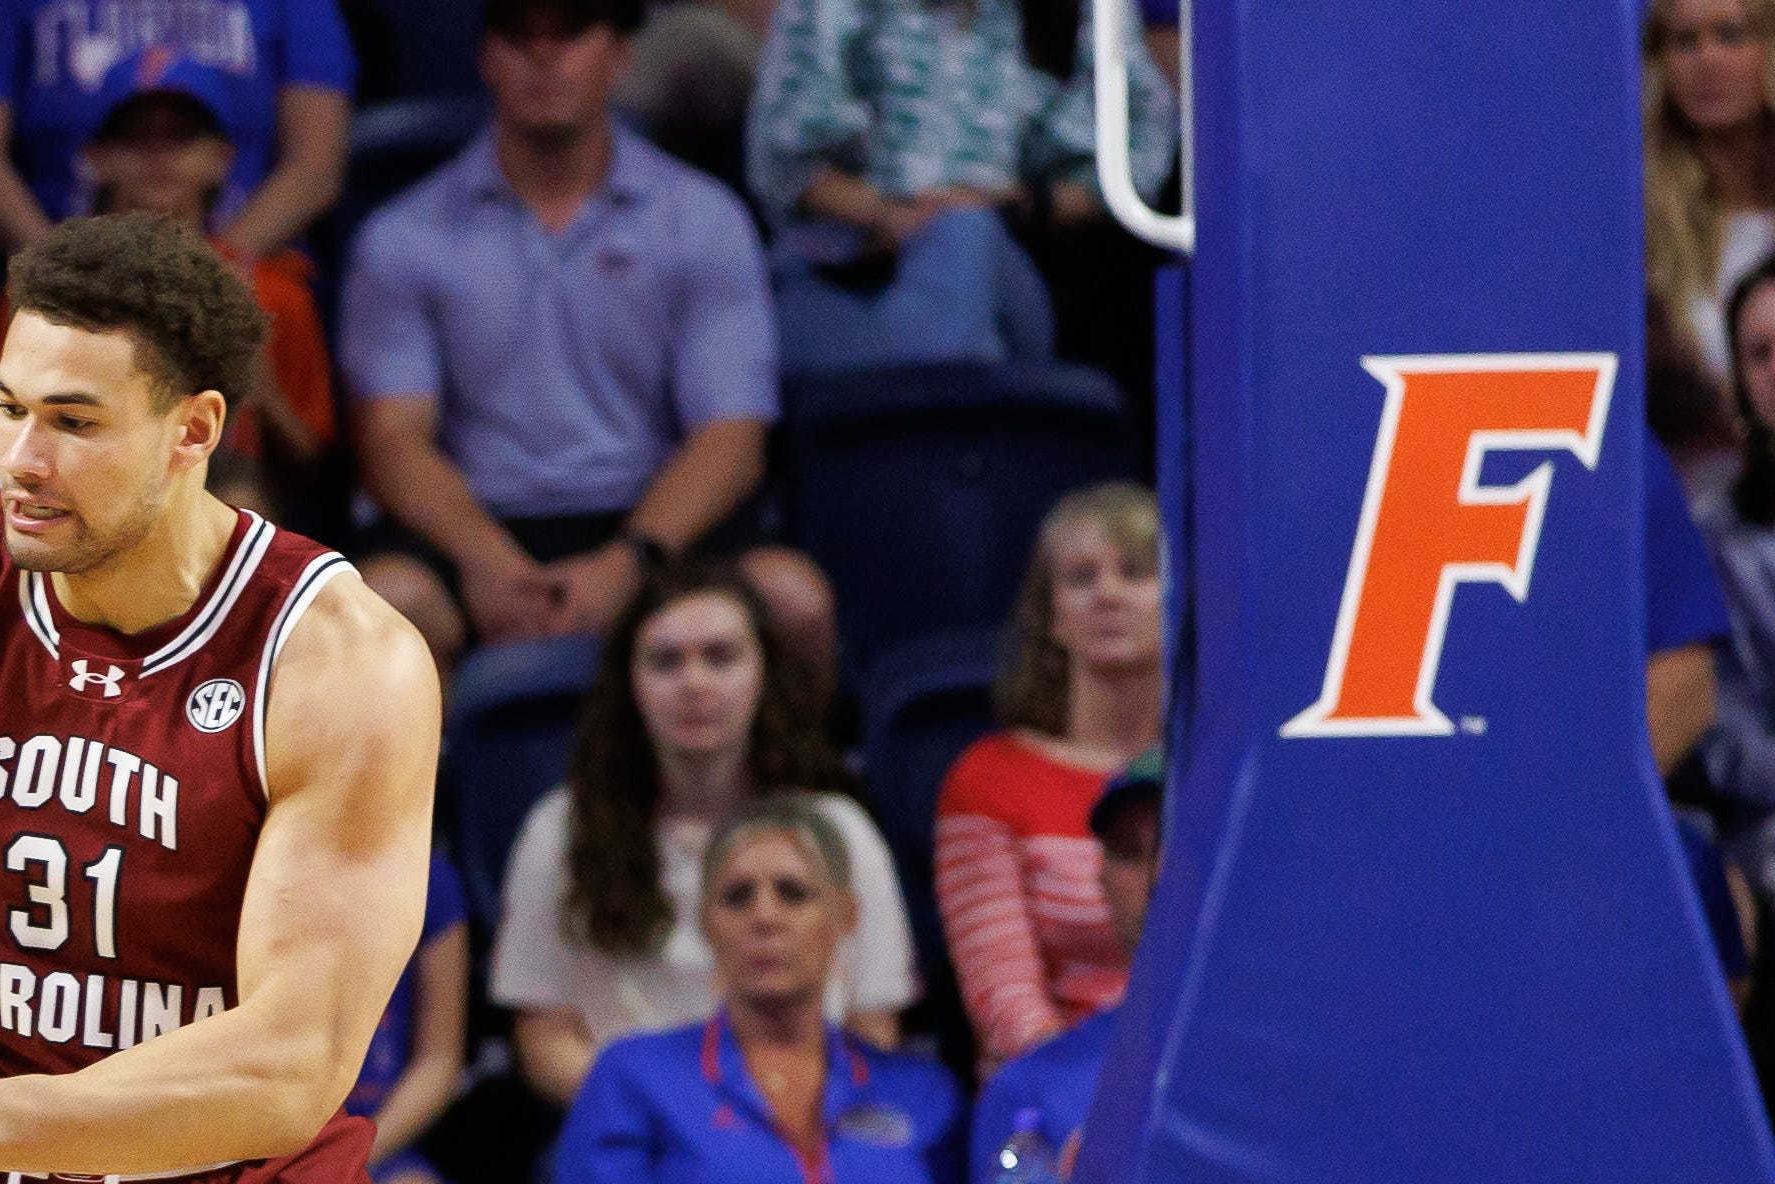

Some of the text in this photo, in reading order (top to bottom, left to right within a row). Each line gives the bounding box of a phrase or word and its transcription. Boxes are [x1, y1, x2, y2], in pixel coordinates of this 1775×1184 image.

[1279, 352, 1619, 737] F
[190, 683, 242, 729] SEC
[4, 834, 123, 959] 31
